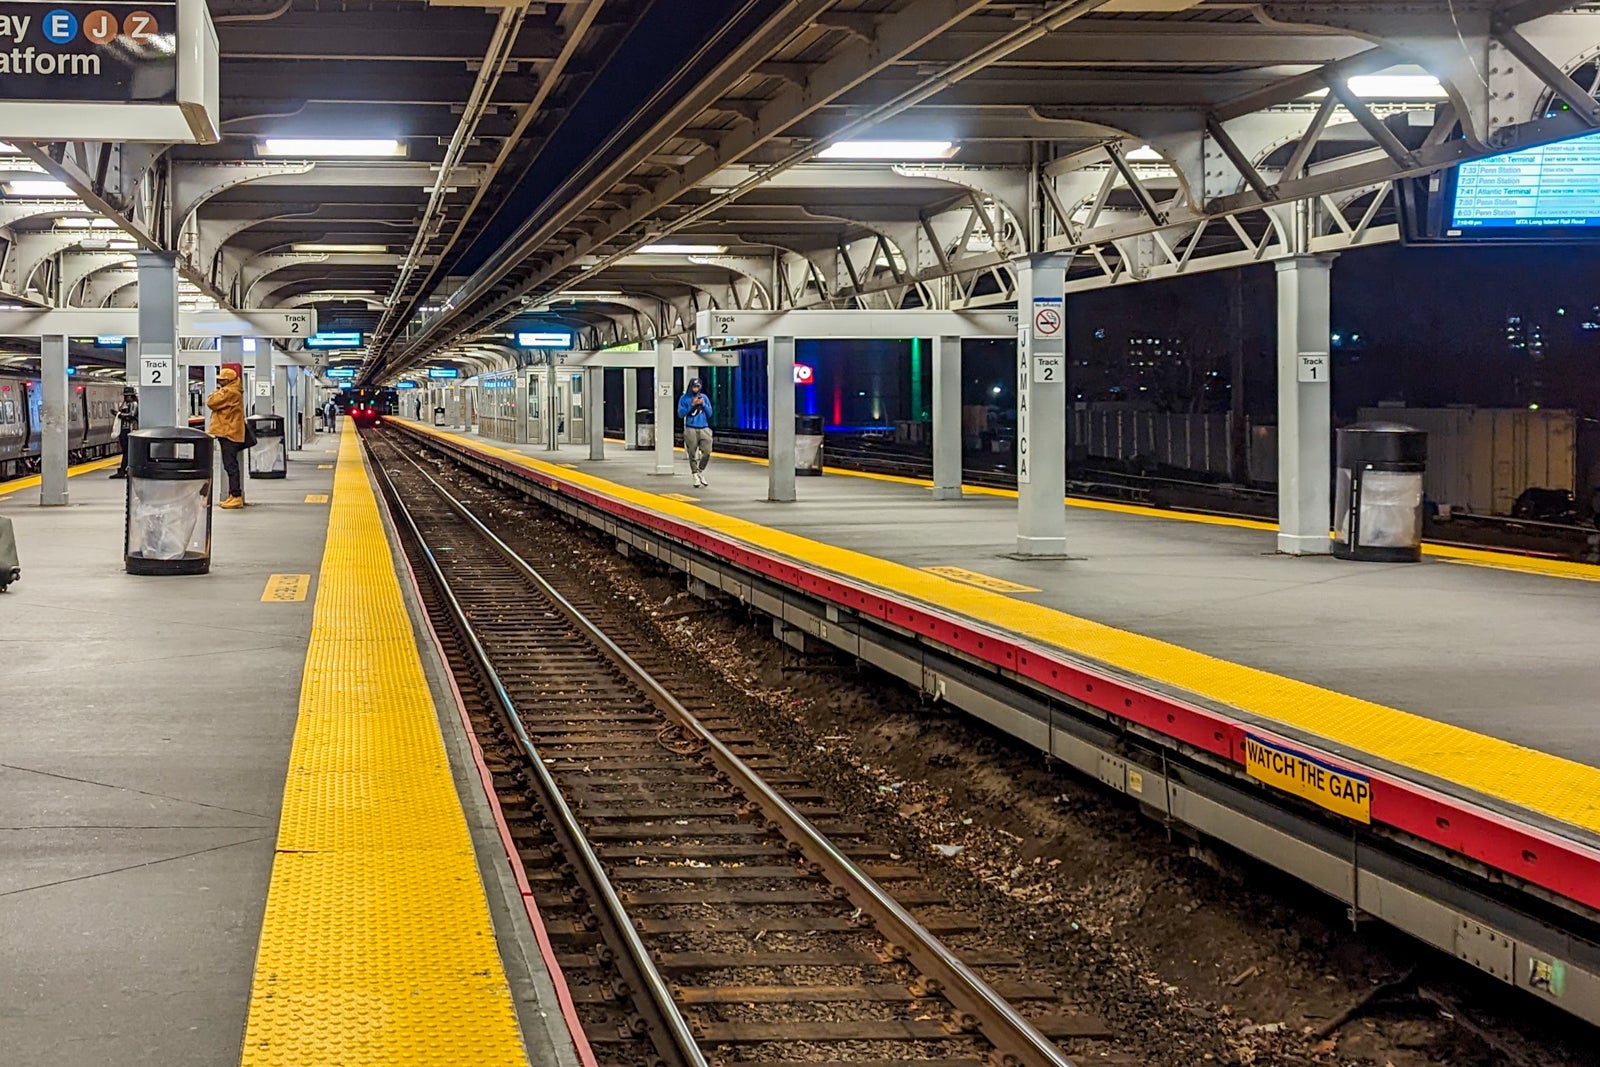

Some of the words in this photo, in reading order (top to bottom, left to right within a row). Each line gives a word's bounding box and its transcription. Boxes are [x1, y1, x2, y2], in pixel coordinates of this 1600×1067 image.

[52, 15, 69, 37] E
[92, 16, 107, 38] J
[132, 17, 150, 38] Z
[291, 323, 299, 333] 2
[721, 324, 728, 333] 2
[152, 370, 161, 383] 2
[1044, 368, 1053, 380] 2
[1310, 367, 1316, 379] 1
[1020, 330, 1028, 476] JAMAICA
[1247, 740, 1295, 778] WATCH
[1299, 761, 1325, 791] THE
[1329, 775, 1368, 804] GAP
